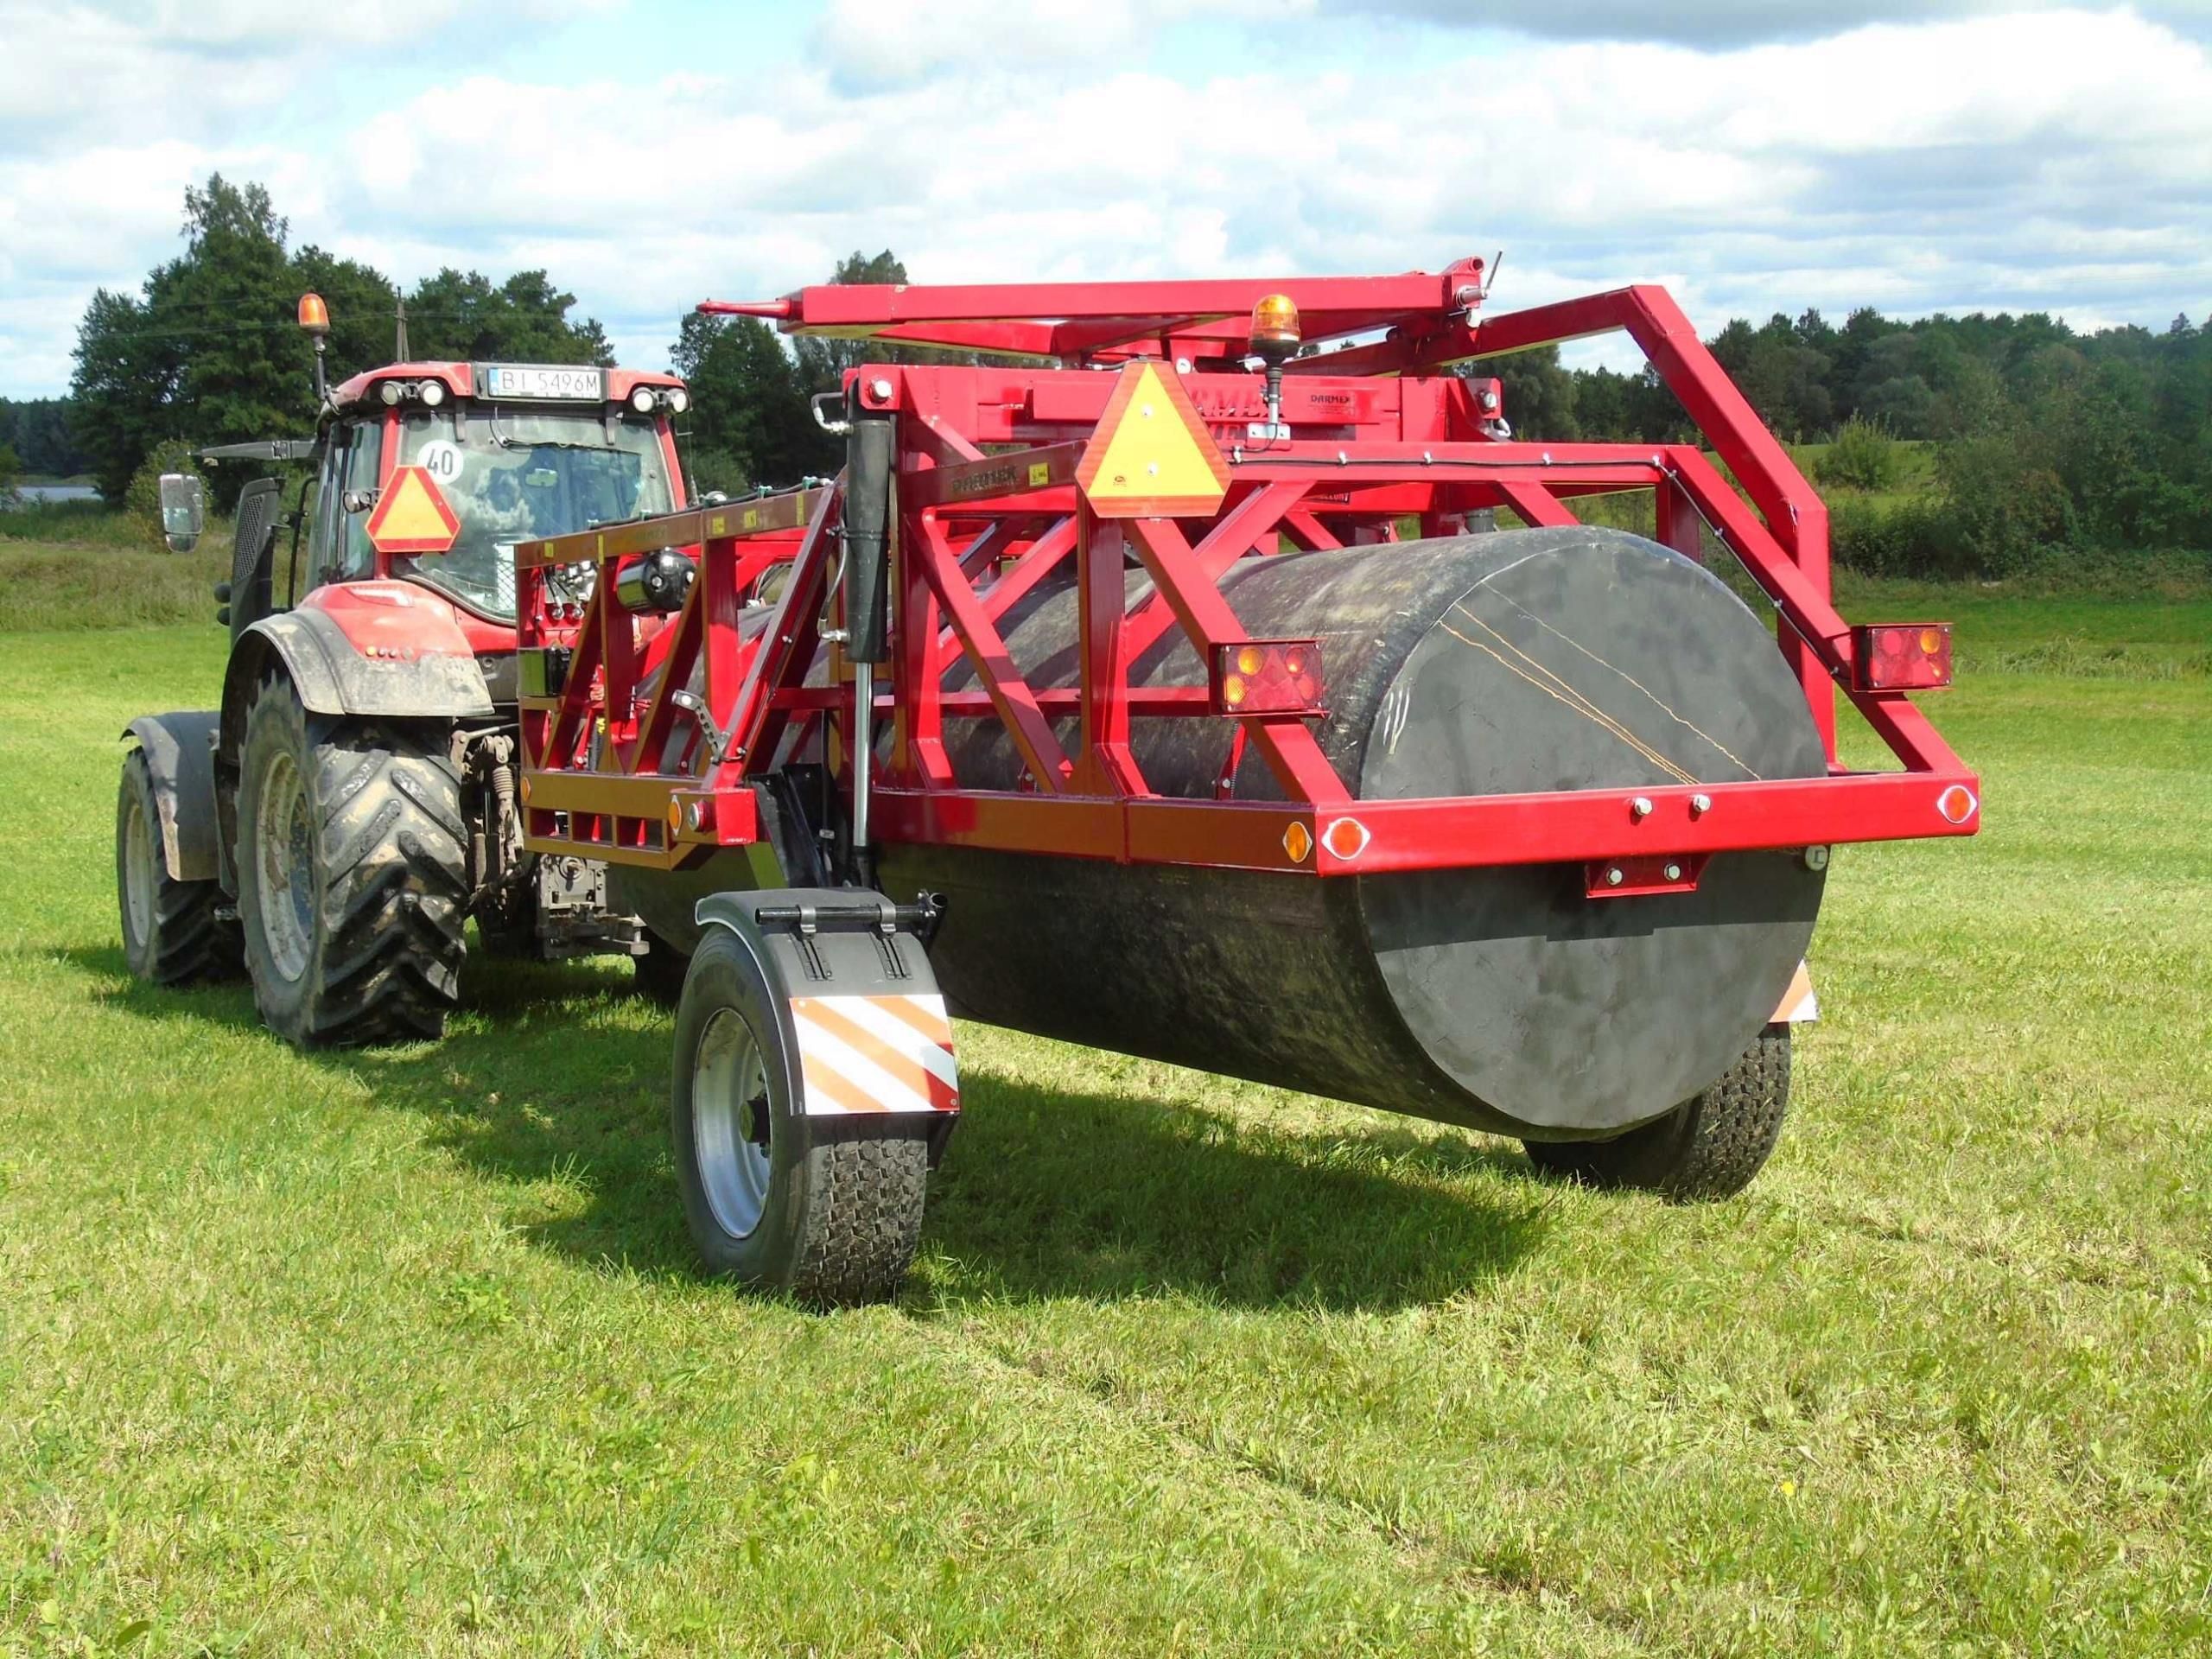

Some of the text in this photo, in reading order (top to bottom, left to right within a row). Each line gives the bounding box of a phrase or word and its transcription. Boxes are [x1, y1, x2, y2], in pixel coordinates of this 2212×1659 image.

[502, 371, 598, 392] BI 5496M
[427, 448, 454, 475] 40
